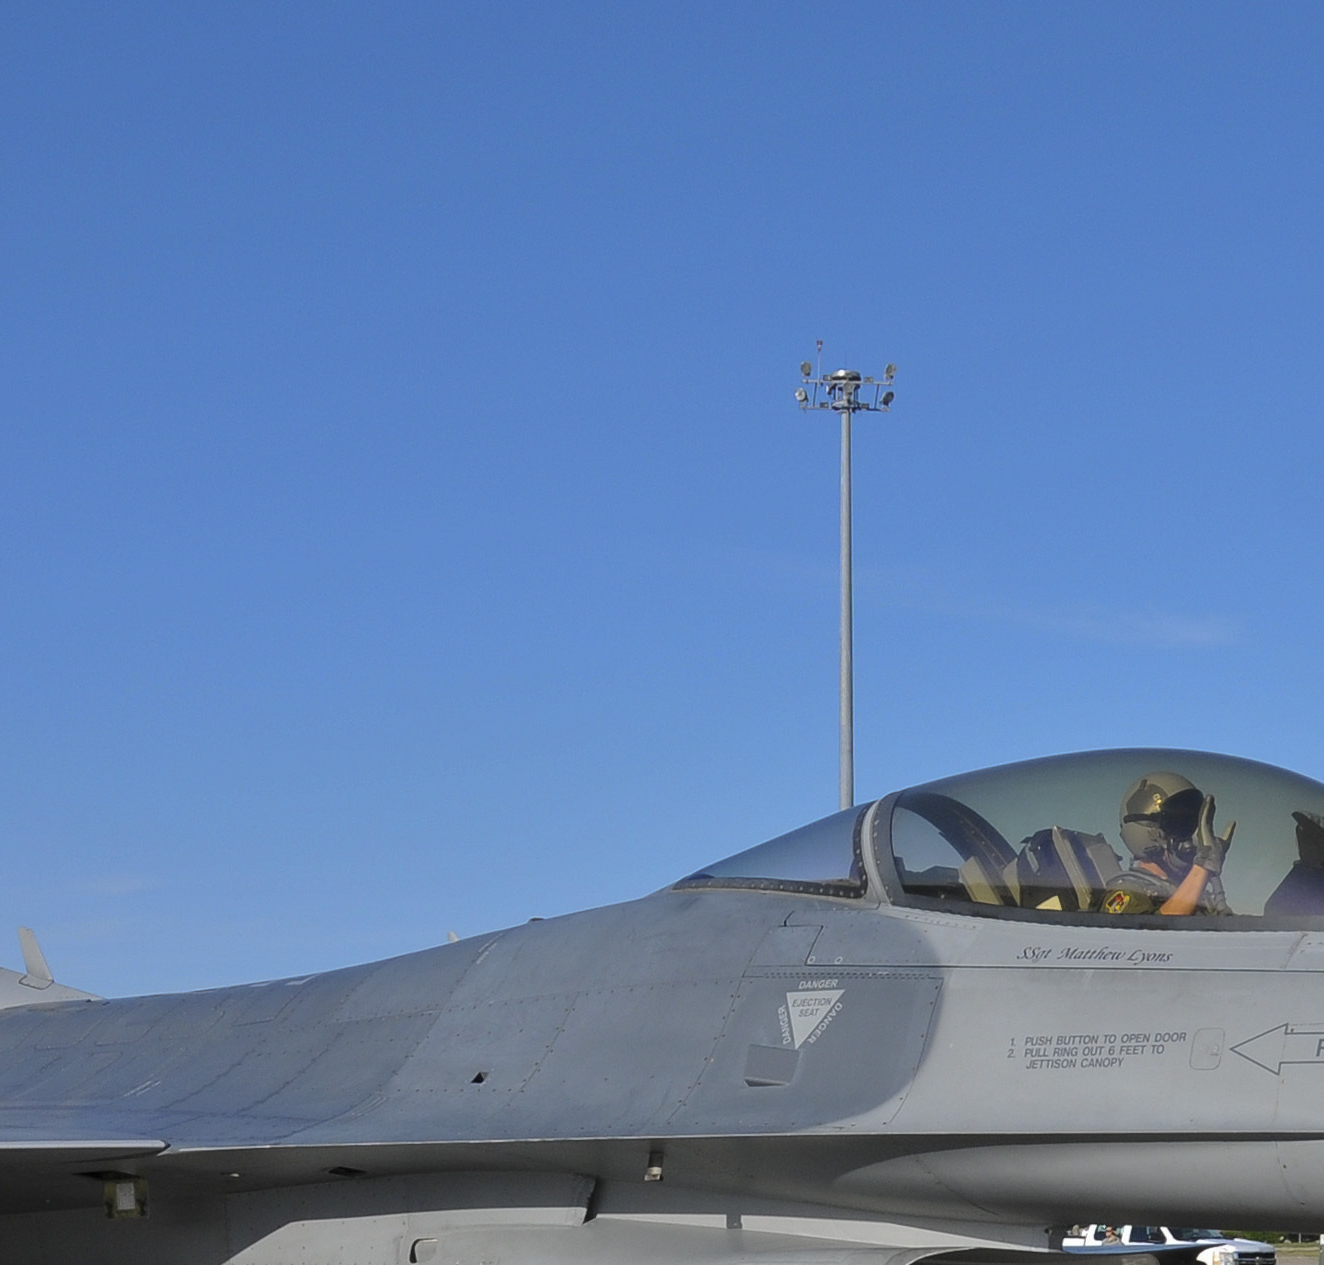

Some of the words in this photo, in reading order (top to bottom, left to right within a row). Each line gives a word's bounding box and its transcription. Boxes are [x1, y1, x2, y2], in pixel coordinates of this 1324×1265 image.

[1016, 946, 1052, 964] SSgt
[1056, 946, 1126, 961] Matthew
[1126, 949, 1174, 966] Lyons
[798, 979, 839, 990] DANGER
[791, 997, 833, 1008] EJECTION
[798, 1008, 820, 1018] SEAT
[777, 1005, 792, 1045] DANGER
[807, 1002, 843, 1044] DANGER
[1024, 1036, 1053, 1047] PUSH
[1056, 1034, 1099, 1046] BUTTON
[1103, 1034, 1117, 1045] TO
[1120, 1033, 1151, 1044] OPEN
[1154, 1032, 1188, 1043] DOOR
[1024, 1048, 1049, 1058] PULL
[1052, 1047, 1079, 1058] RING
[1082, 1046, 1105, 1057] OUT
[1108, 1045, 1115, 1056] 6
[1119, 1045, 1147, 1056] FEET
[1151, 1044, 1165, 1055] TO
[1025, 1058, 1077, 1069] JETTISON
[1080, 1057, 1125, 1068] CANOPY
